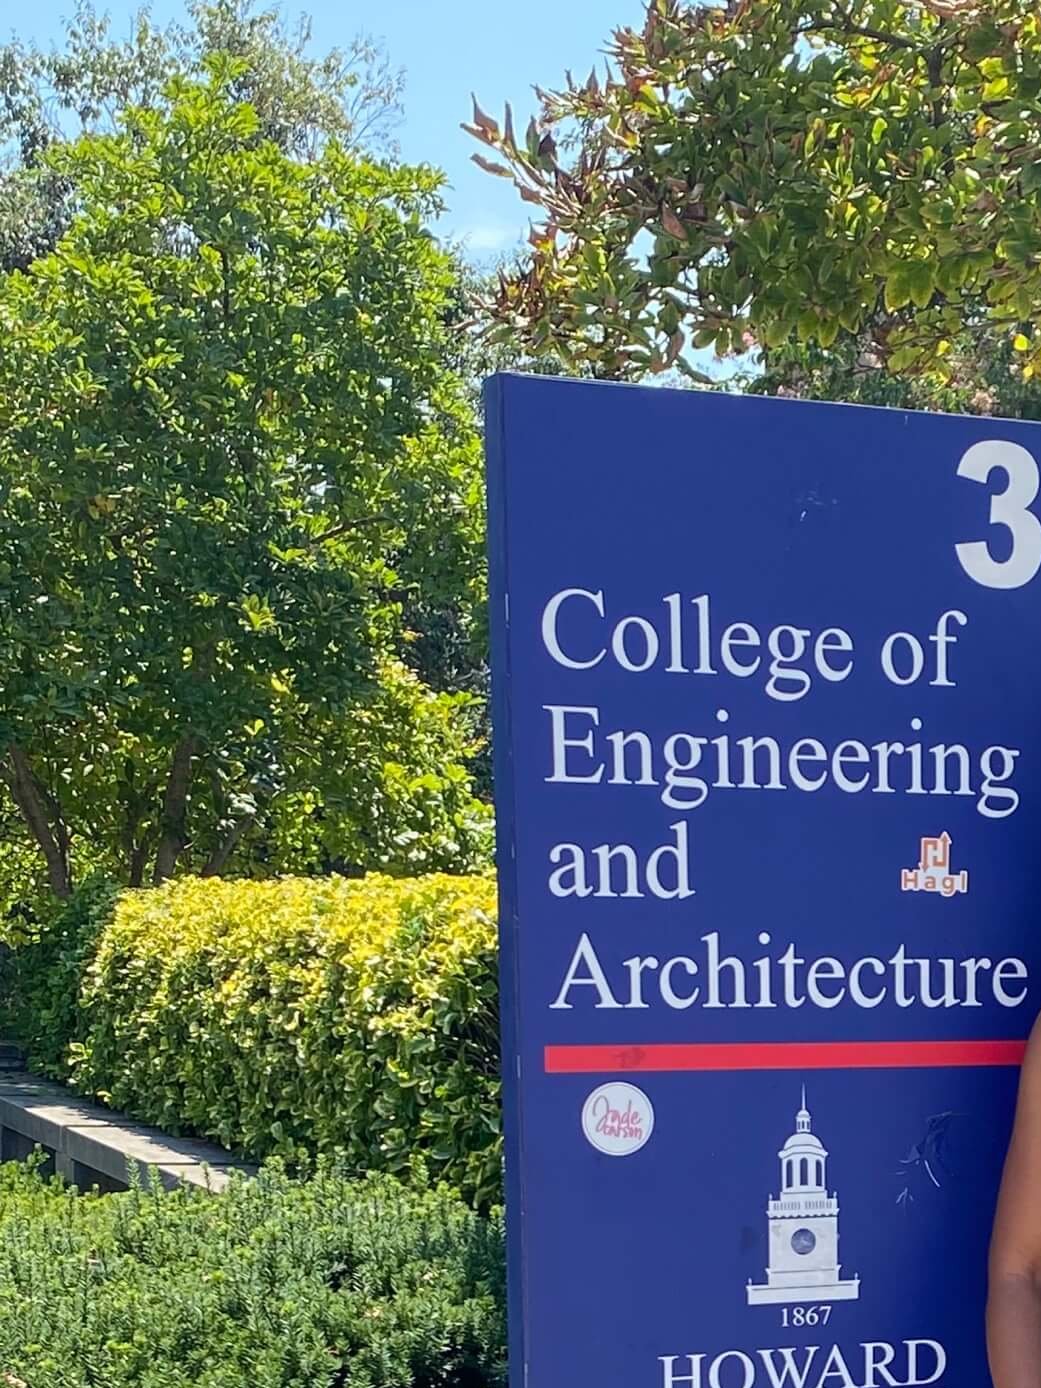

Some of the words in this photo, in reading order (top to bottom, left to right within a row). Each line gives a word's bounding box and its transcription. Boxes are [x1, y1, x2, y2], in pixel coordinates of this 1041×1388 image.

[541, 588, 853, 701] College
[881, 610, 968, 686] of
[542, 705, 1020, 818] Engineering
[548, 820, 696, 900] and
[548, 931, 1028, 1010] Architecture
[781, 1305, 832, 1327] 1867
